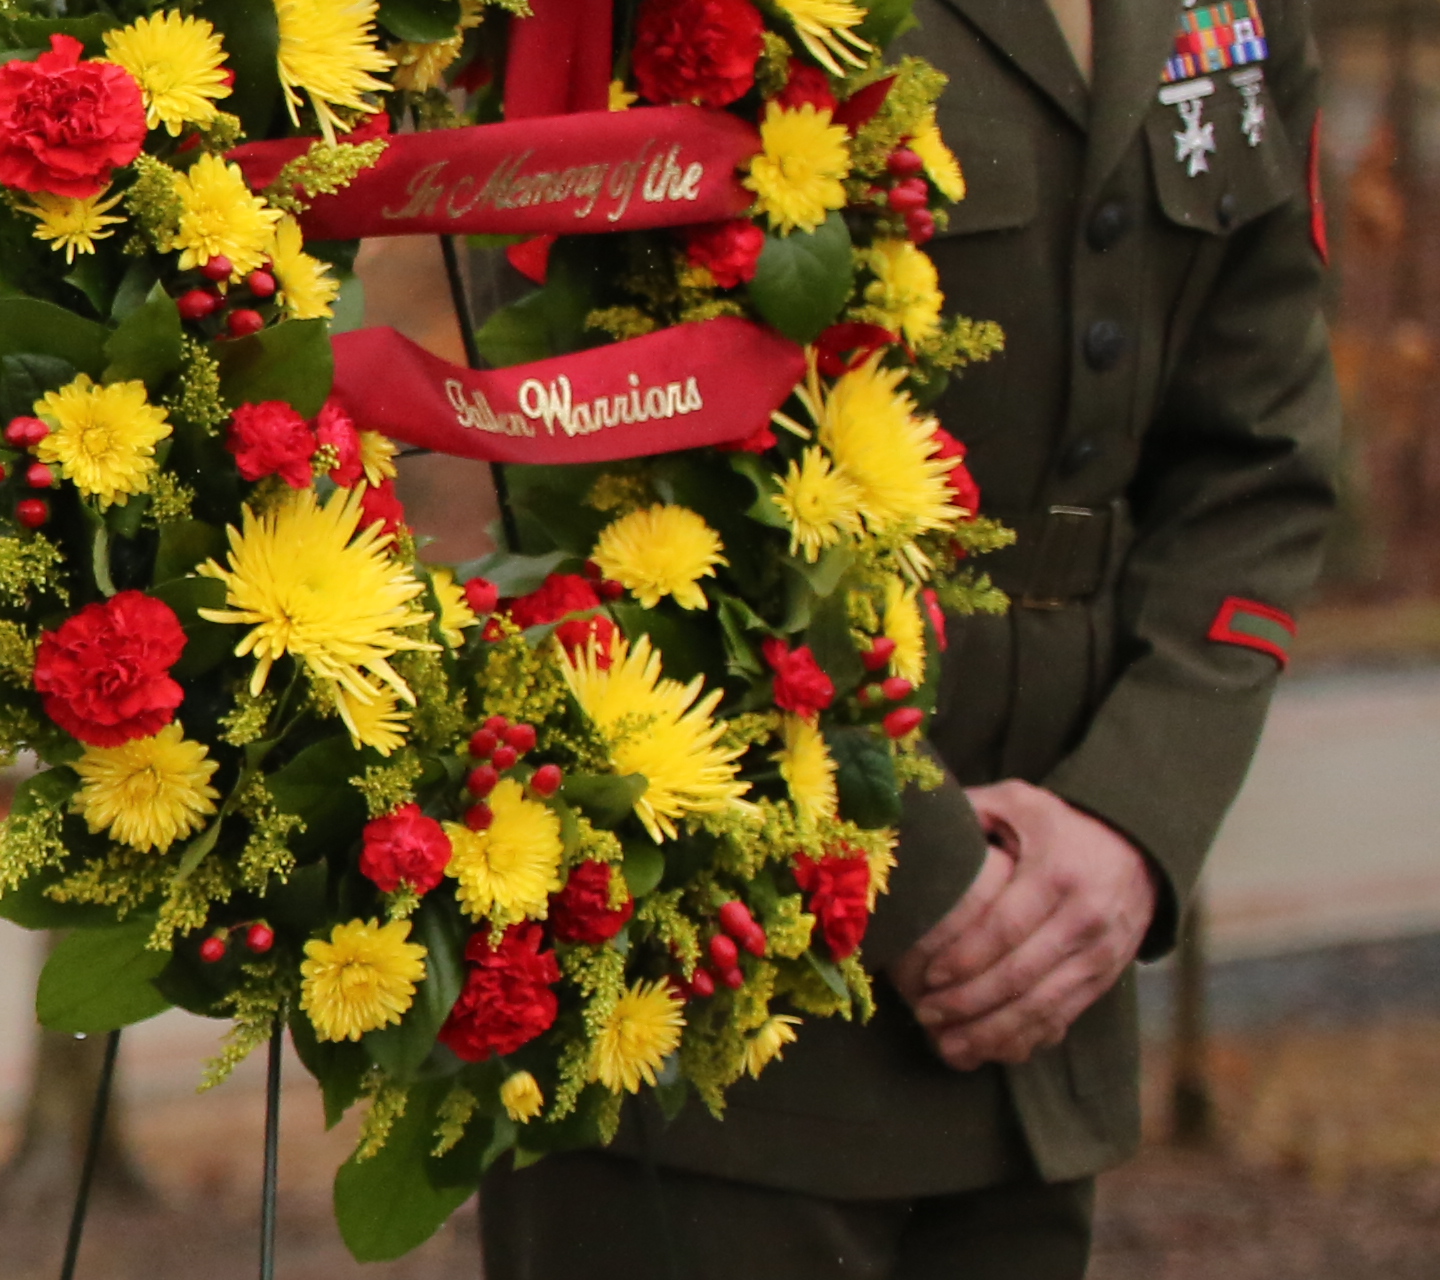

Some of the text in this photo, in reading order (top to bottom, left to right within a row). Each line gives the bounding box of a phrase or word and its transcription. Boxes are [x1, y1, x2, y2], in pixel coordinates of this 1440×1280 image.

[446, 149, 609, 219] Memory
[643, 144, 703, 202] the
[518, 373, 703, 438] Warriors
